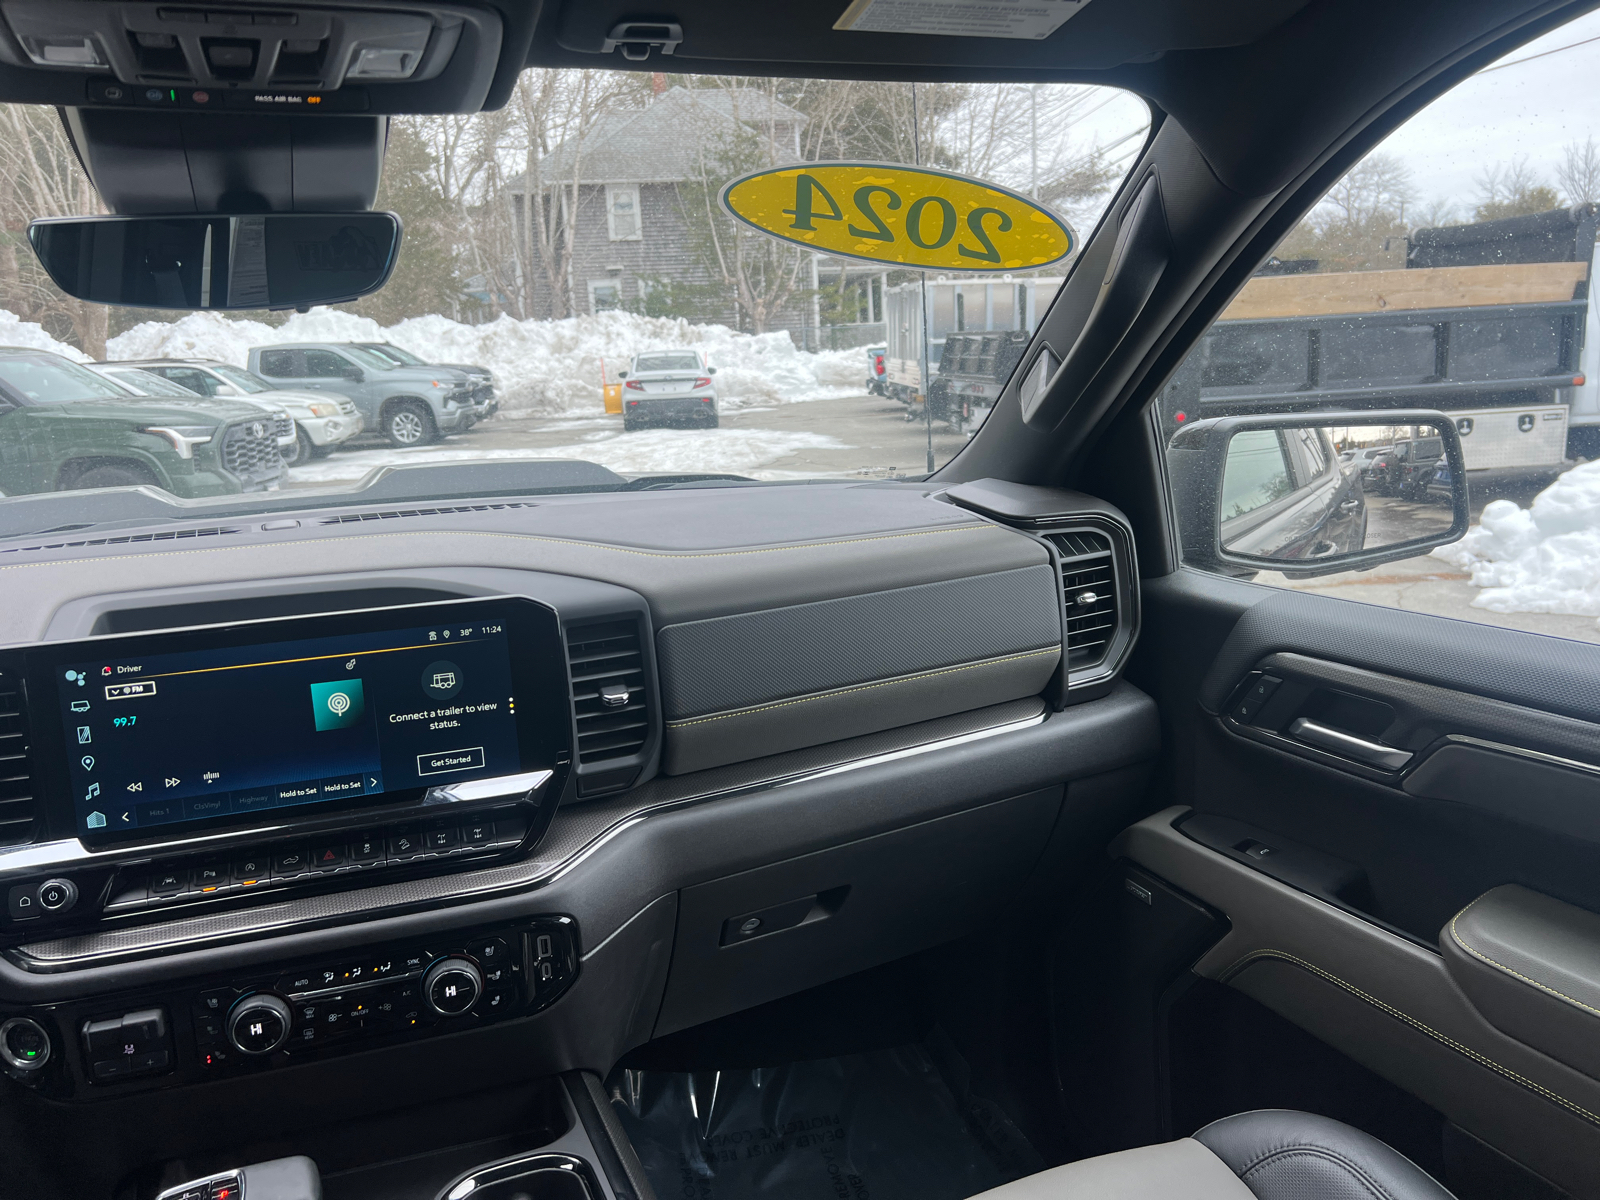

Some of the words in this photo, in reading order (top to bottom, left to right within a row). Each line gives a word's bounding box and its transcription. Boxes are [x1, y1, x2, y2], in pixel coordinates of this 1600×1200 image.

[254, 95, 273, 103] PASS
[274, 95, 286, 103] AIR
[287, 96, 302, 104] BAG
[307, 96, 321, 104] OFF
[481, 625, 502, 635] 11:24
[116, 665, 143, 674] Driver
[131, 685, 144, 693] FM
[389, 710, 428, 723] Connect
[437, 706, 464, 717] trailer
[465, 705, 475, 714] to
[476, 702, 498, 712] view
[113, 716, 137, 728] 99.7
[429, 719, 461, 730] status.
[430, 758, 445, 768] Get
[445, 754, 472, 766] Started
[279, 790, 296, 799] Hold
[305, 787, 318, 795] Set
[324, 783, 341, 793] Hold
[350, 781, 362, 789] Set
[238, 794, 269, 805] Highway
[149, 809, 164, 817] Hits
[406, 957, 420, 965] SYNC
[294, 978, 309, 987] AUTO
[445, 984, 457, 997] HI
[350, 1008, 370, 1018] ON/OFF
[250, 1022, 263, 1036] HI
[756, 1113, 841, 1139] PROTECTVE
[795, 1127, 846, 1149] DEALER
[745, 1140, 785, 1160] MUST
[820, 1146, 851, 1200] REMOVE
